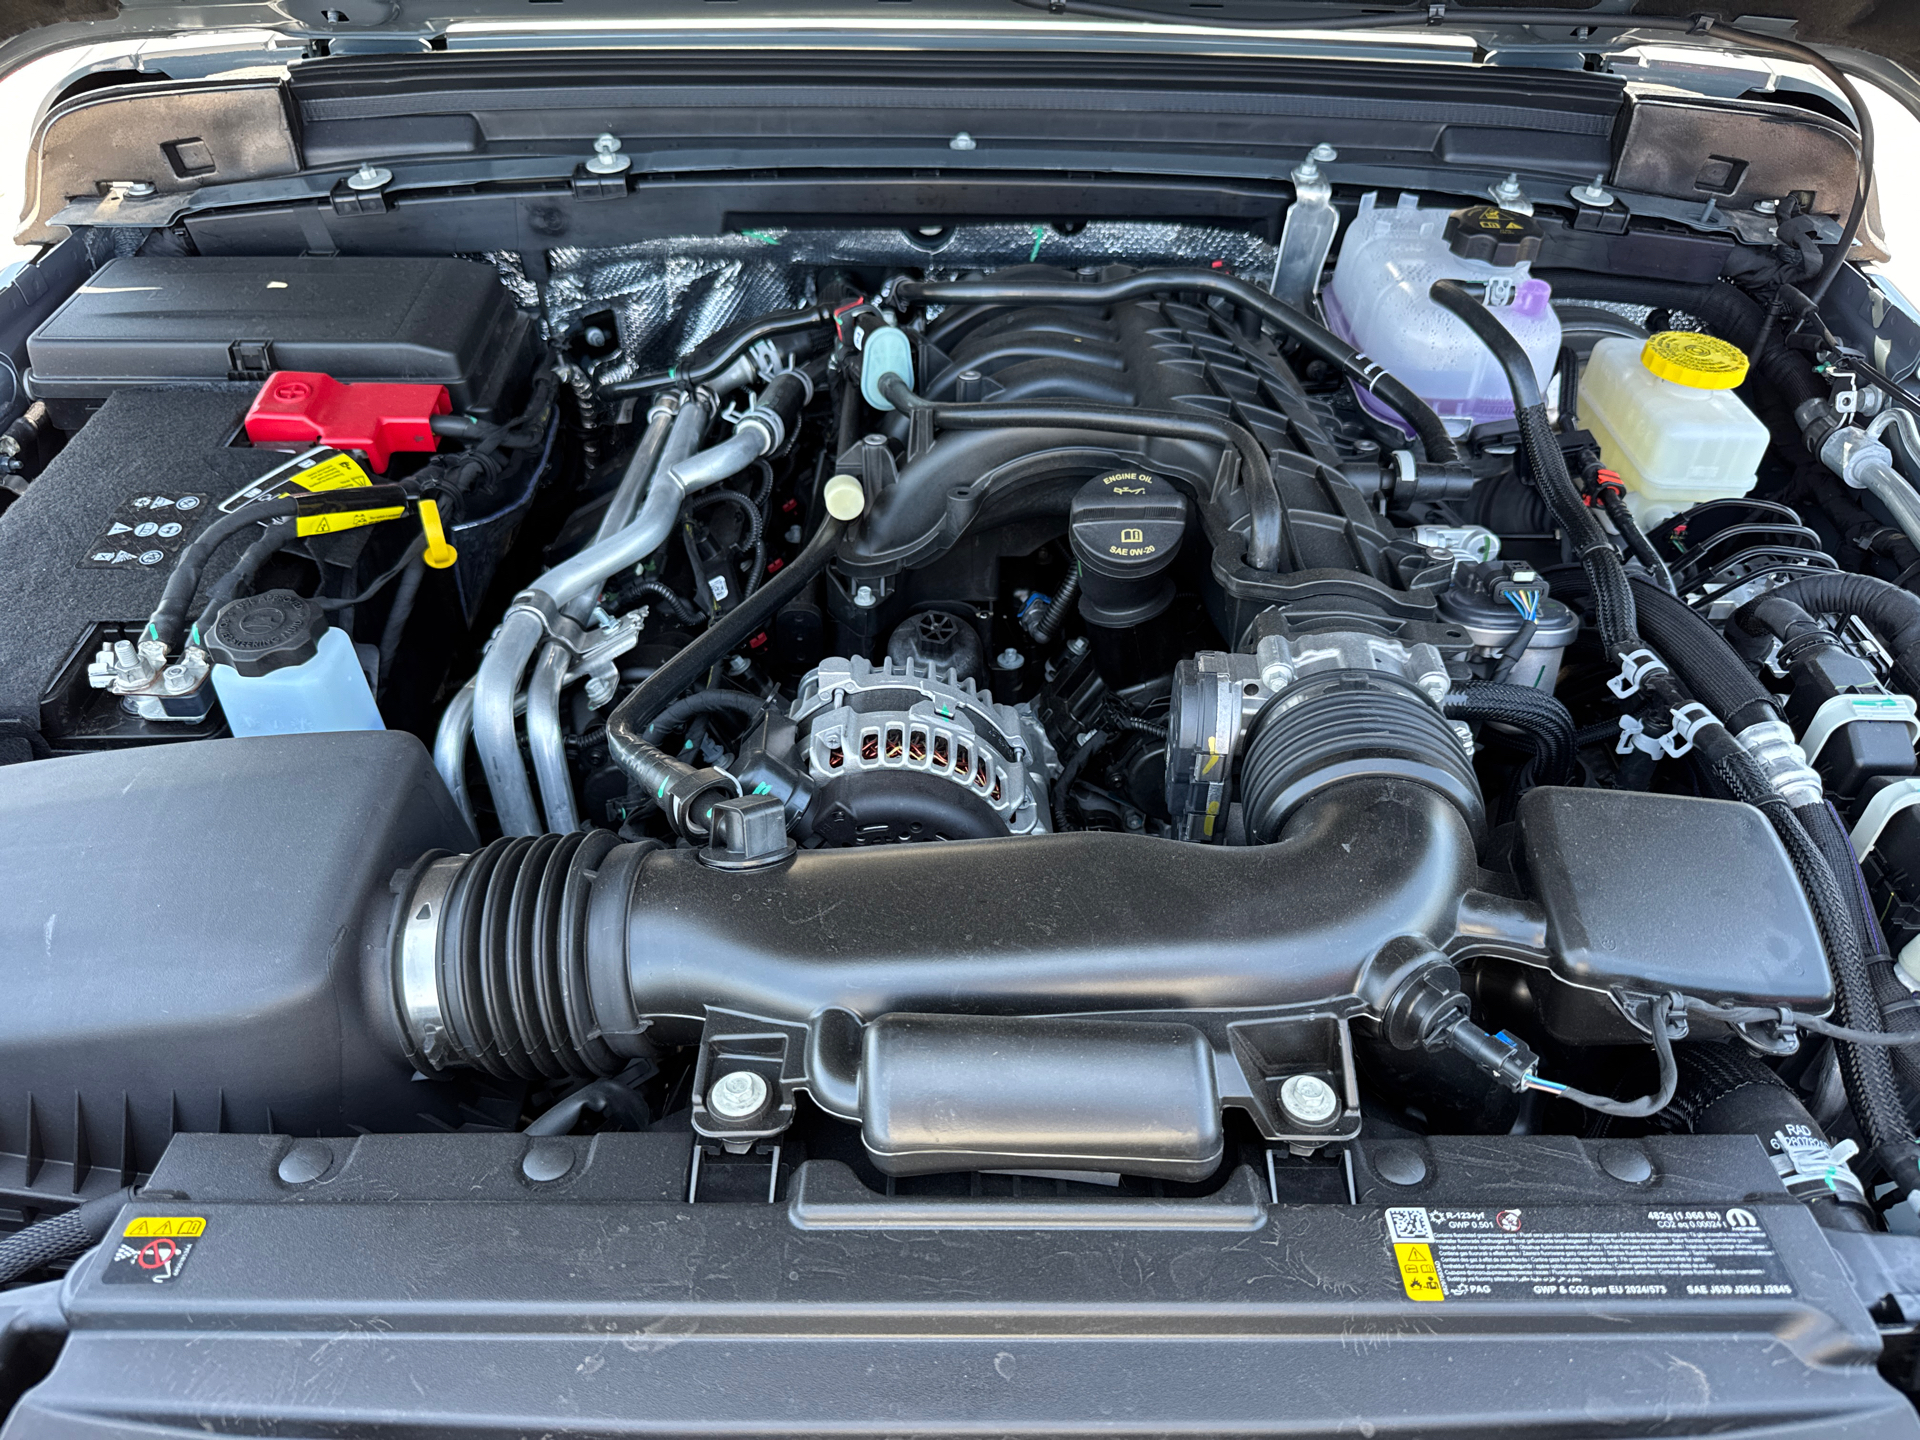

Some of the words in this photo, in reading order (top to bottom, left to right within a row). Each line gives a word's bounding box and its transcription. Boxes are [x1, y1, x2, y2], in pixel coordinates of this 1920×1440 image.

[1103, 473, 1137, 485] ENGINE
[1139, 474, 1153, 484] OIL
[1109, 545, 1128, 556] SAE
[1129, 545, 1156, 556] 0W-20
[1785, 1124, 1811, 1136] RAD
[1445, 1211, 1485, 1221] R-1234yf
[1647, 1211, 1674, 1221] 482g
[1448, 1221, 1470, 1229] GWP
[1471, 1221, 1494, 1229] 0.501
[1656, 1220, 1677, 1228] CO2
[1470, 1285, 1492, 1294] PAG
[1533, 1285, 1557, 1295] GWP
[1559, 1285, 1568, 1295] &
[1568, 1285, 1591, 1295] CO2
[1591, 1286, 1607, 1296] per
[1608, 1285, 1624, 1295] EU
[1624, 1285, 1667, 1295] 2024/573
[1686, 1285, 1708, 1295] SAE
